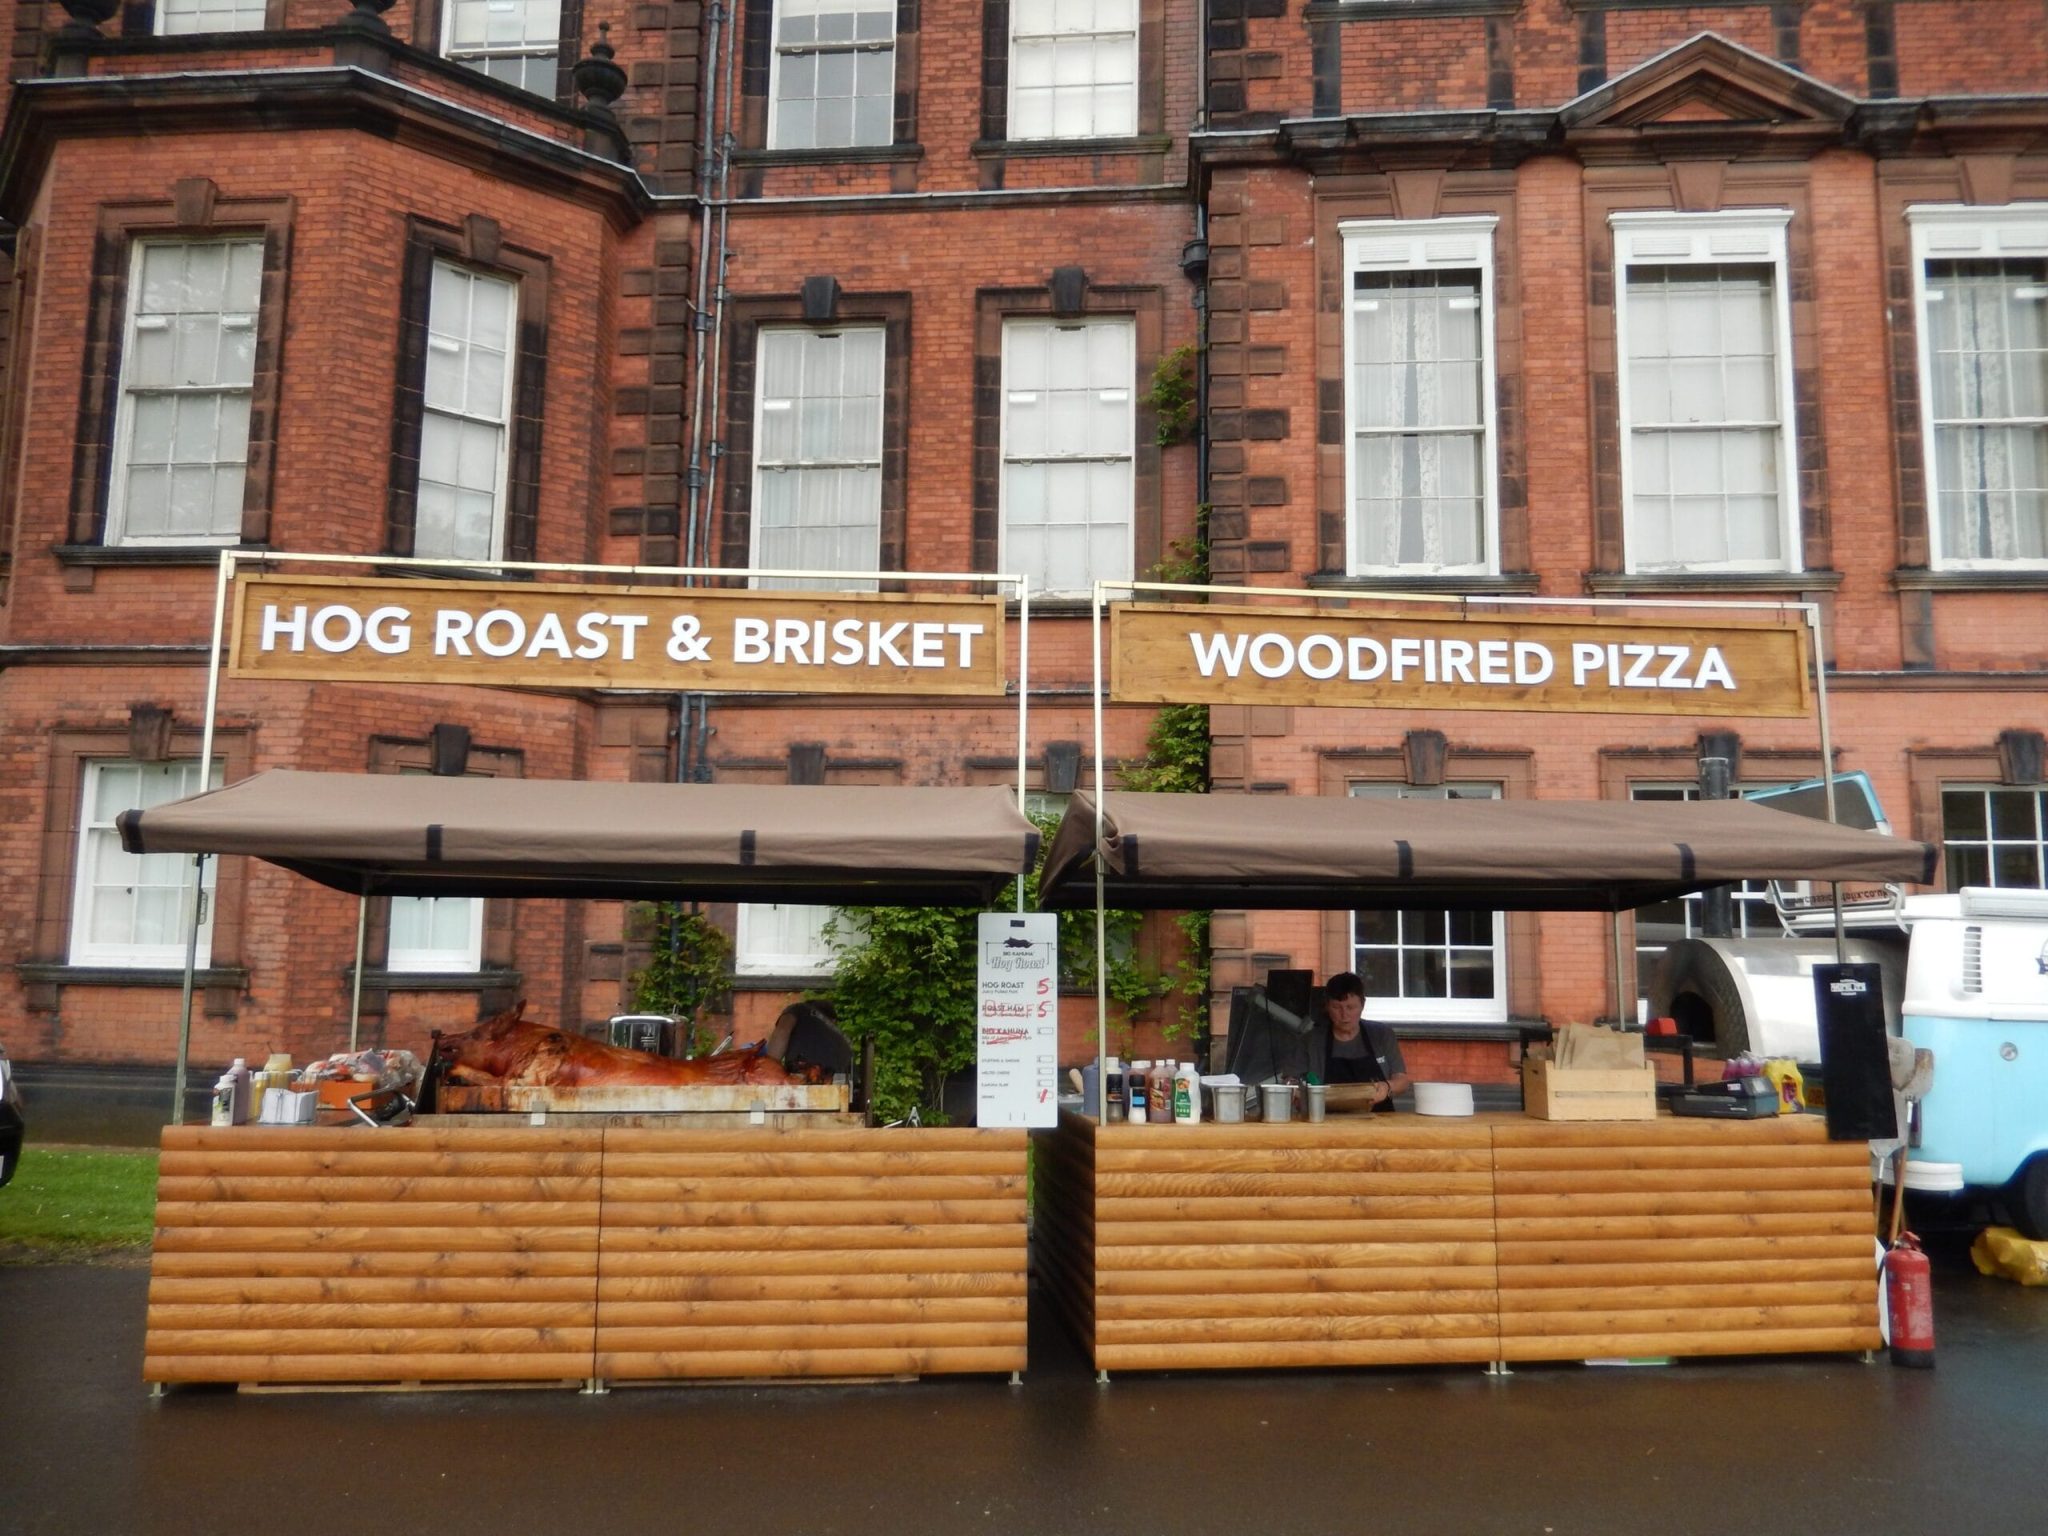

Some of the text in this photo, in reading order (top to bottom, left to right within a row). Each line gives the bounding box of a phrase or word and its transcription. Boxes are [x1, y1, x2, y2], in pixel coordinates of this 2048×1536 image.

[261, 605, 983, 667] HOG ROAST & BRISKET
[1190, 633, 1736, 689] WOODFIRED PIZZA
[982, 981, 1024, 989] HOG ROAST
[1036, 977, 1050, 995] 5
[1037, 1000, 1052, 1018] 5
